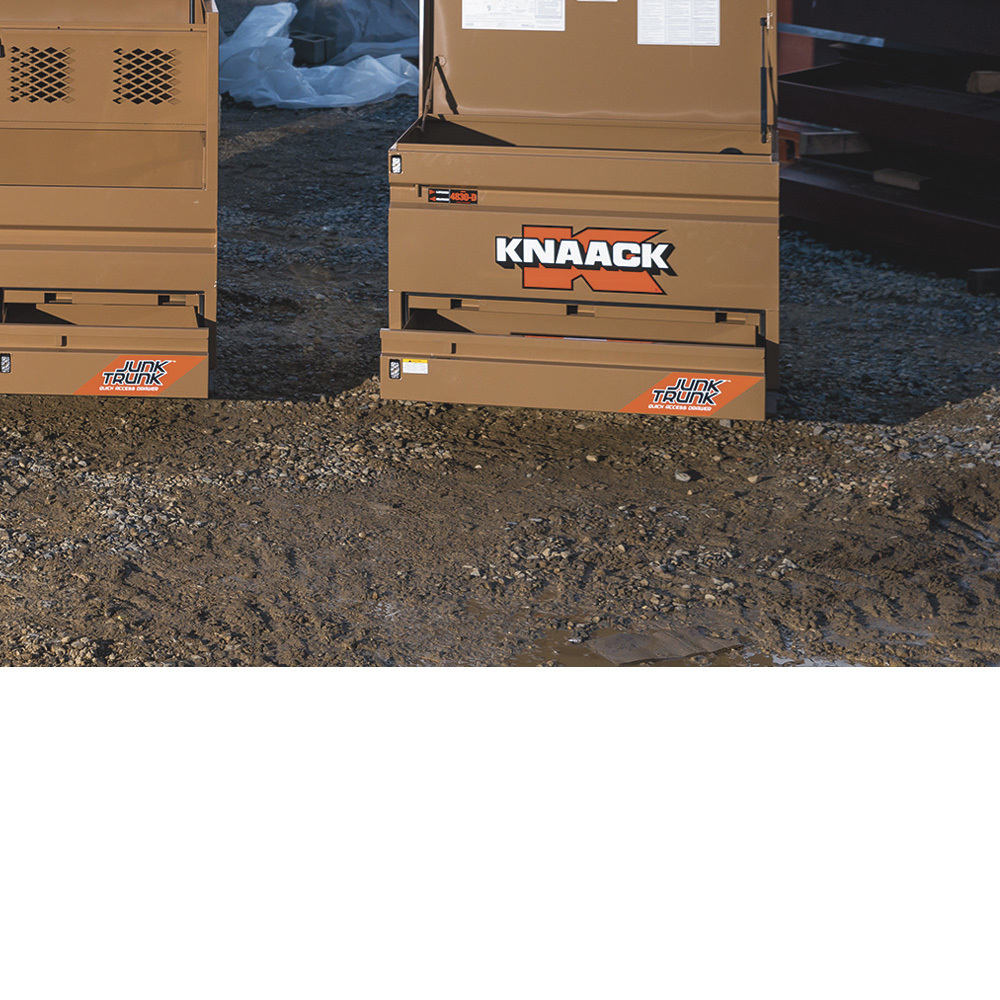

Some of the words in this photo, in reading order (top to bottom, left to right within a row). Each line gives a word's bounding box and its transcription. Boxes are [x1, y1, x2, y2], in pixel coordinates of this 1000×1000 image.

[495, 236, 673, 272] KNAACK
[115, 360, 172, 373] JUNK
[102, 372, 163, 386] TRUNK
[666, 378, 726, 393] JUNK
[652, 389, 716, 406] TRUNK
